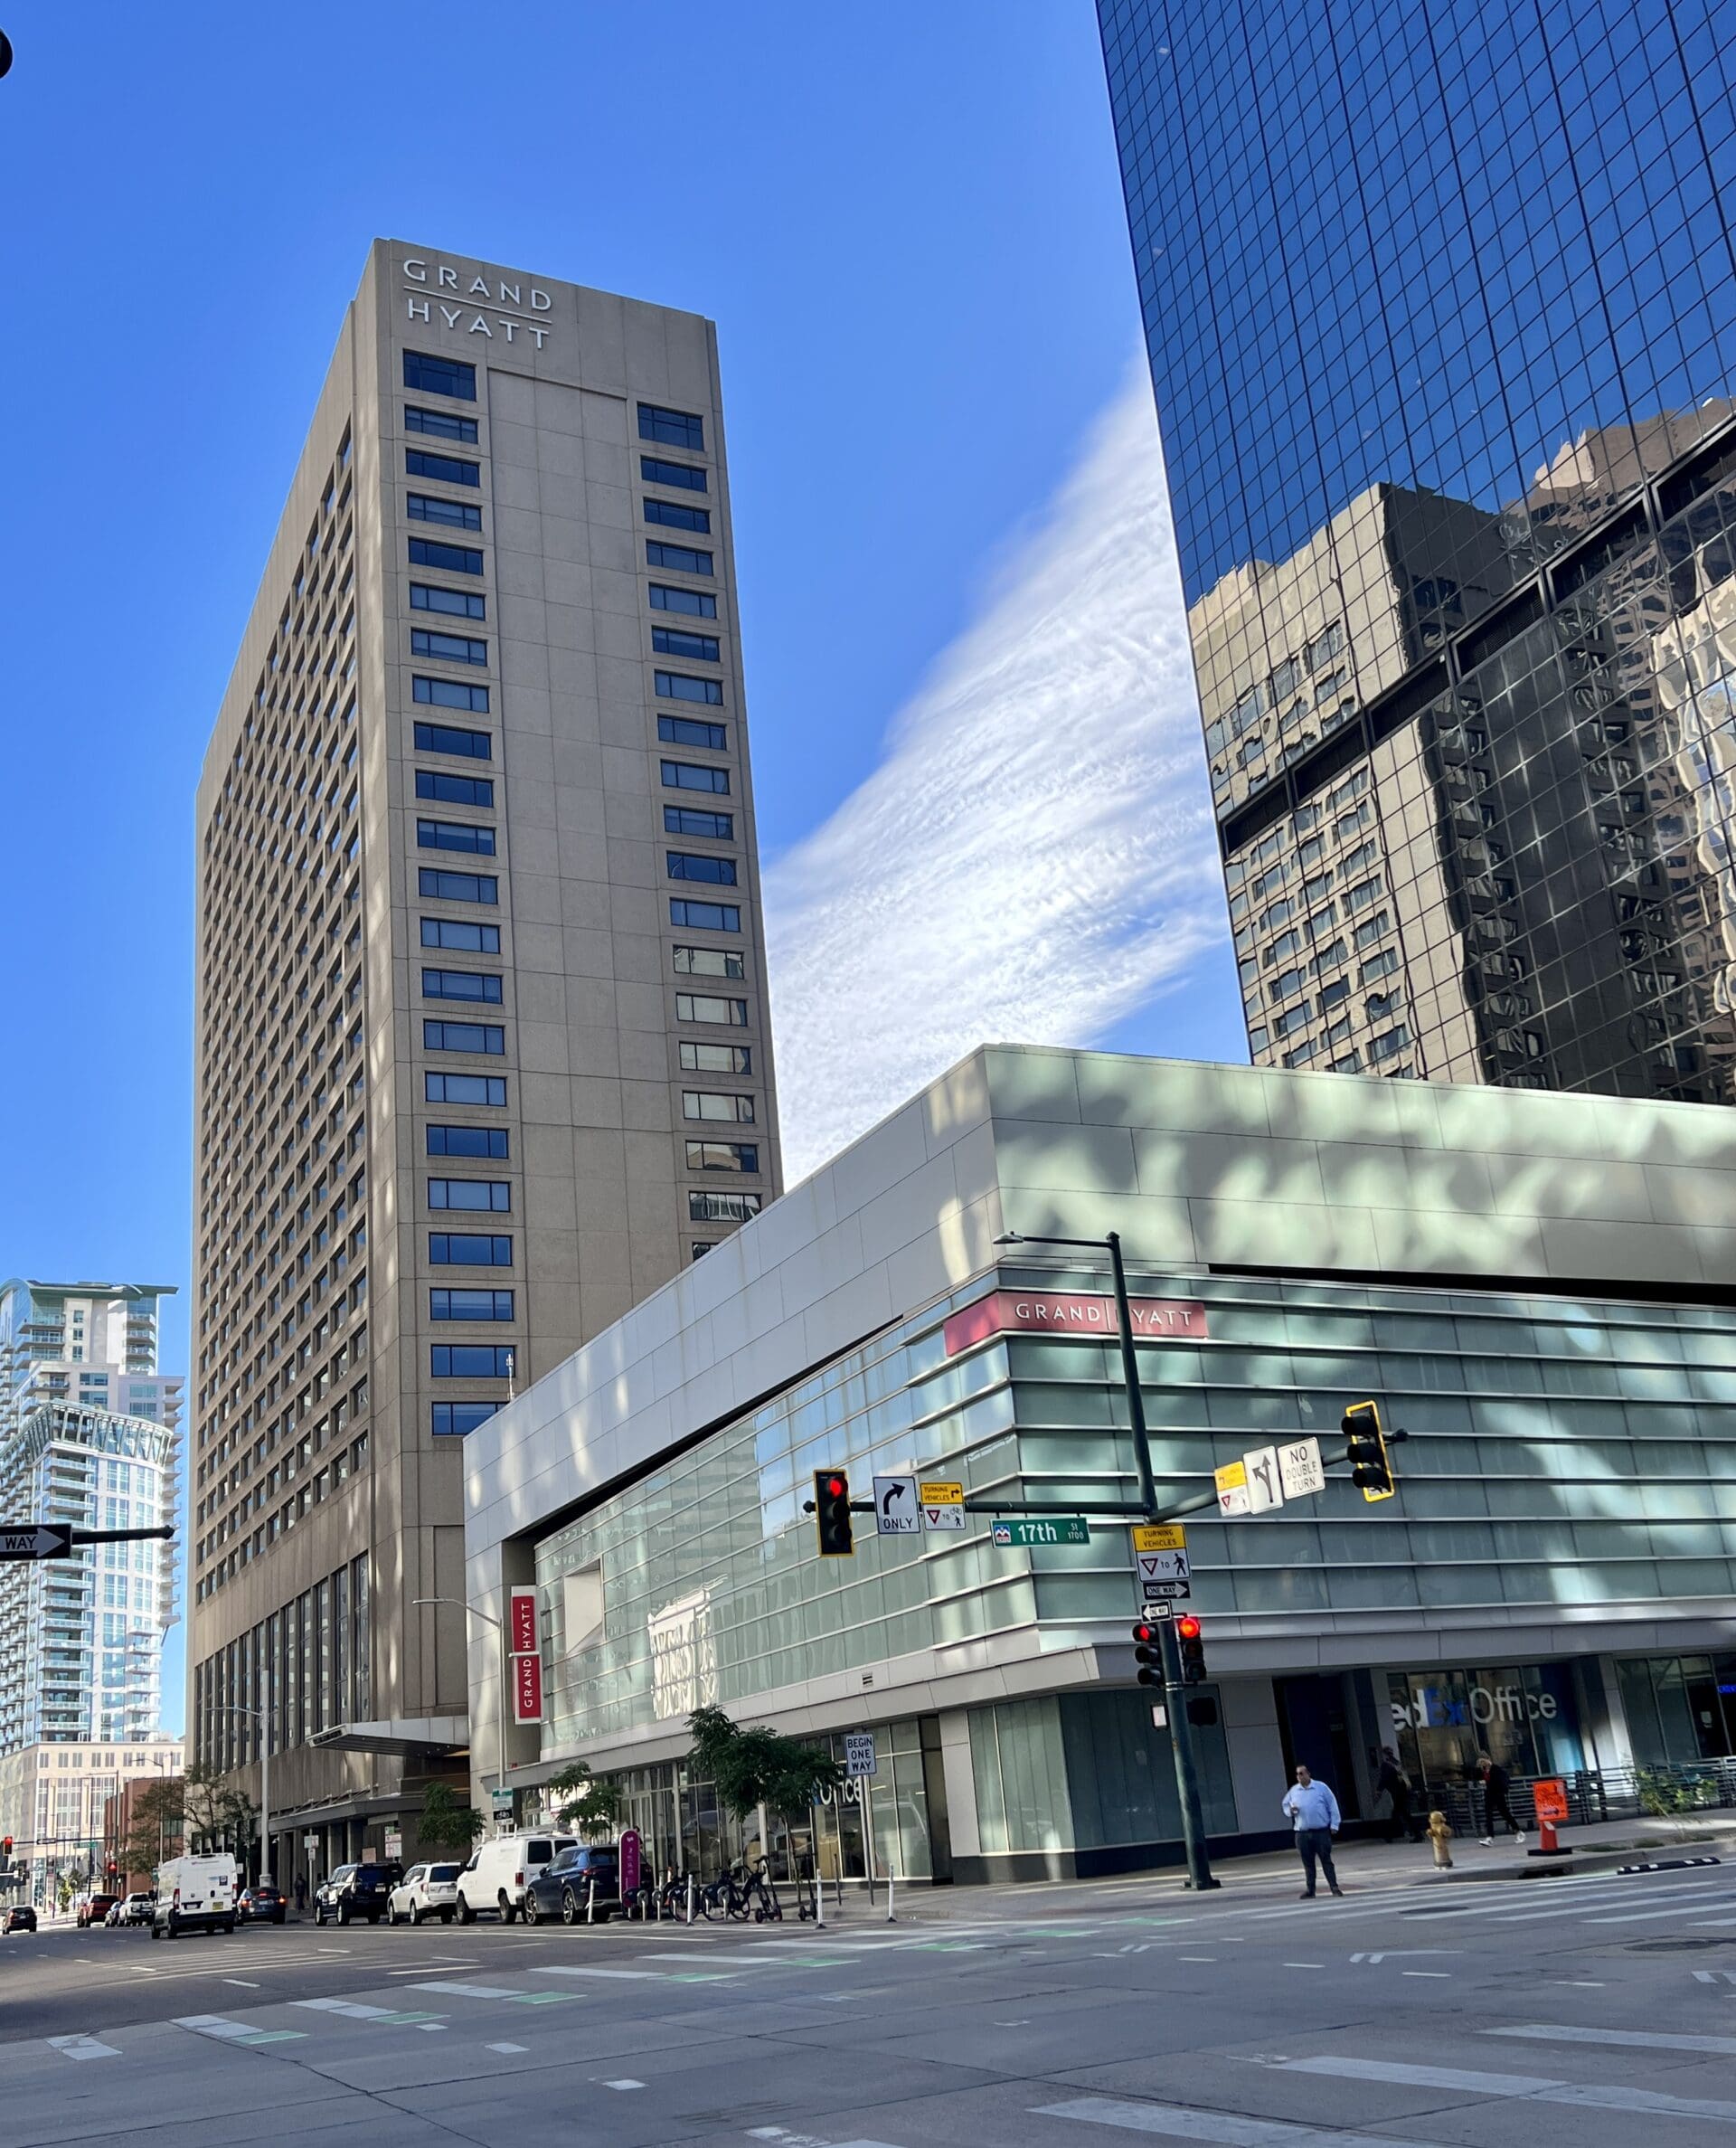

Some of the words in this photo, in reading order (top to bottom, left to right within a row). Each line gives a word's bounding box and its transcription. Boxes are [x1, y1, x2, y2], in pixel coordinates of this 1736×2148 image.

[403, 259, 552, 311] GRAND
[408, 298, 550, 350] HYATT
[1015, 1302, 1100, 1322] GRAND
[1116, 1309, 1192, 1327] YATT
[1289, 1446, 1308, 1464] NO
[1286, 1461, 1318, 1481] DOUBLE
[1293, 1476, 1316, 1490] TURN
[883, 1518, 913, 1529] ONLY
[1018, 1522, 1057, 1542] 17th
[1068, 1531, 1084, 1539] 1700
[1144, 1528, 1174, 1538] TURNING
[5, 1536, 37, 1549] WAY
[1144, 1538, 1177, 1547] VEHICLES
[1161, 1561, 1170, 1569] TO
[1148, 1586, 1161, 1594] ONE
[1163, 1585, 1175, 1594] WAY
[521, 1604, 532, 1649] HYATT
[524, 1659, 533, 1708] GRAND
[1470, 1685, 1557, 1724] Office
[847, 1736, 873, 1748] BEGIN
[851, 1749, 871, 1760] ONE
[852, 1761, 872, 1772] WAY
